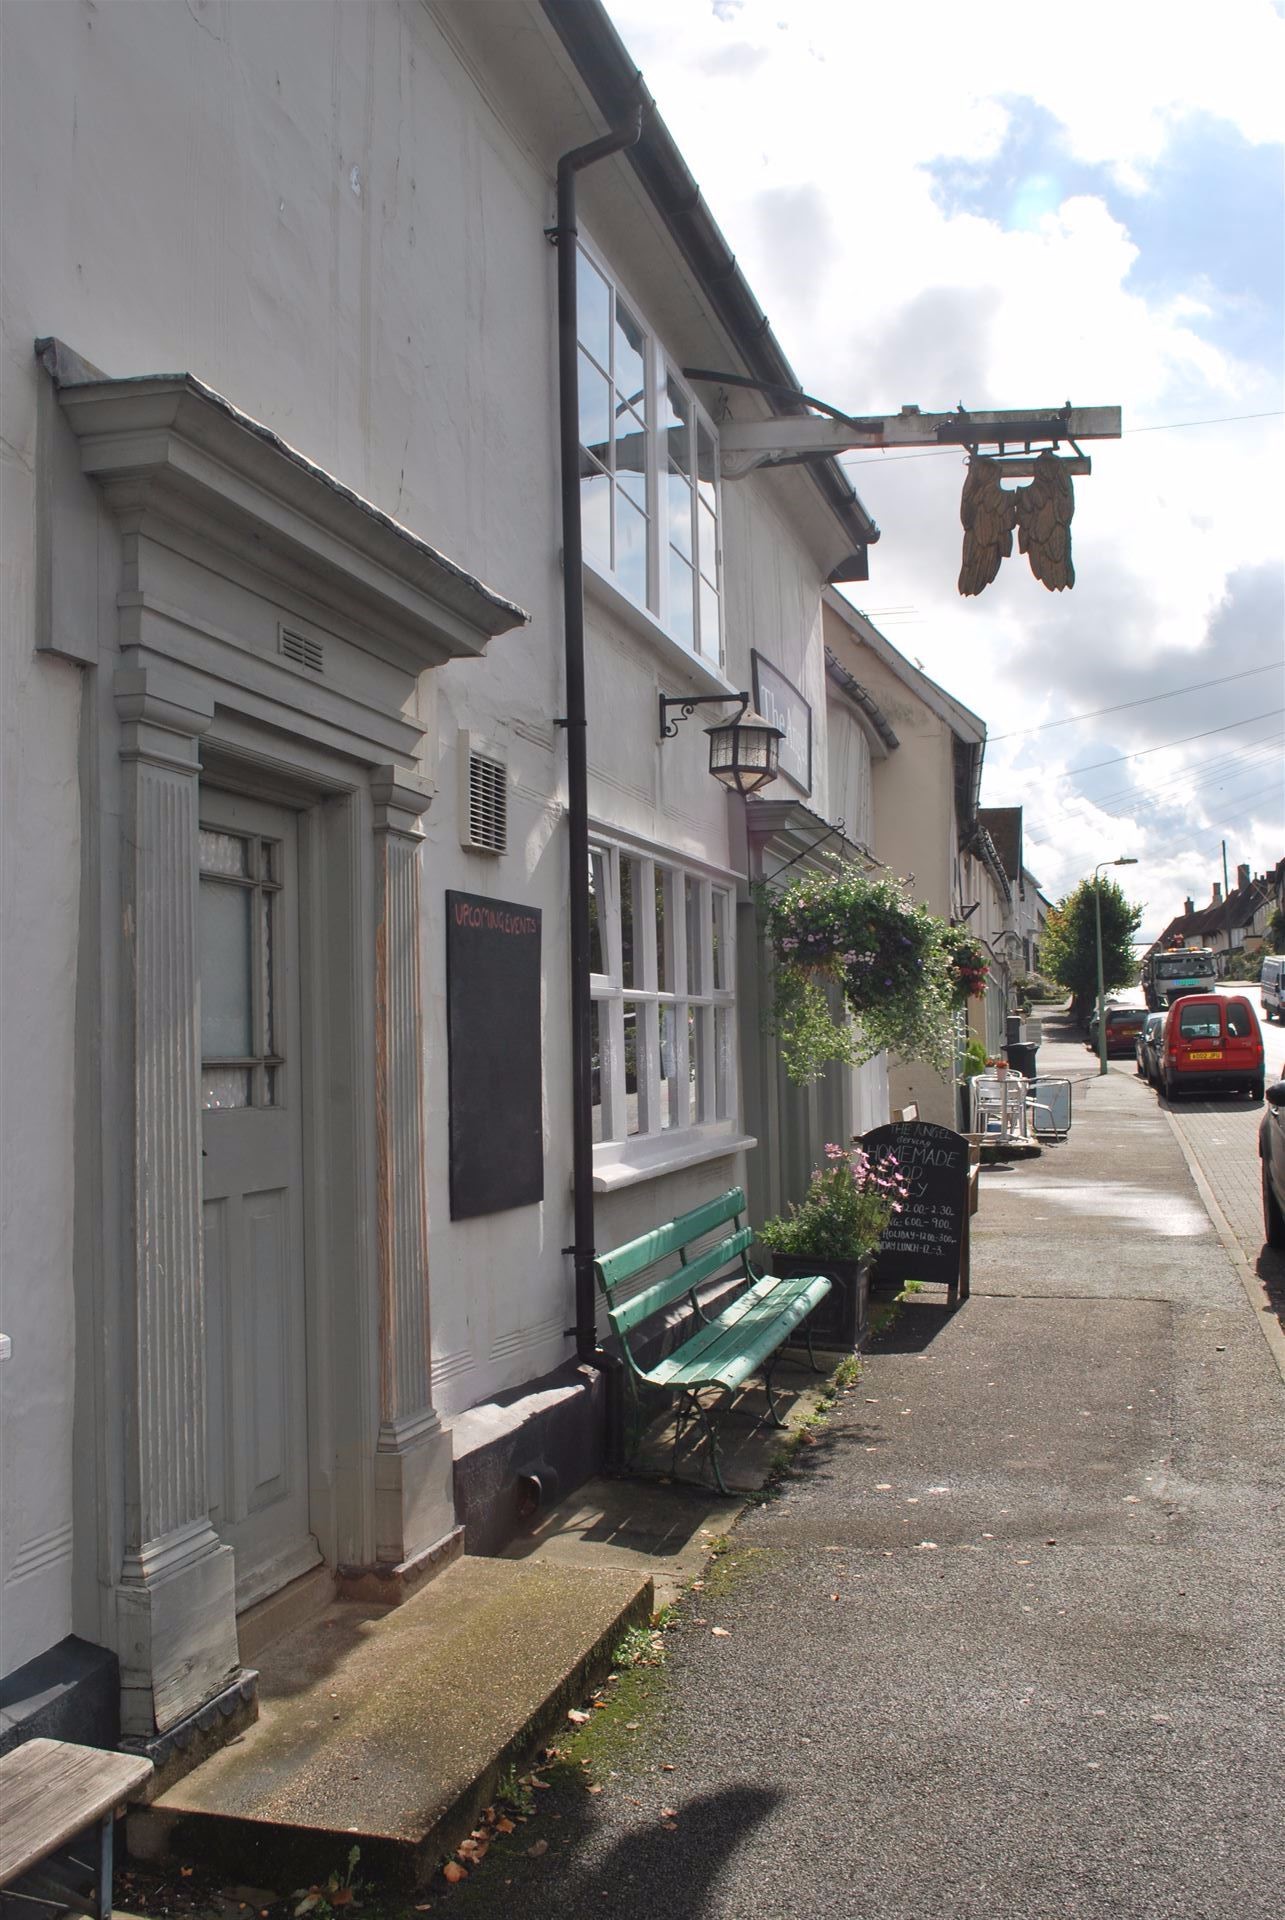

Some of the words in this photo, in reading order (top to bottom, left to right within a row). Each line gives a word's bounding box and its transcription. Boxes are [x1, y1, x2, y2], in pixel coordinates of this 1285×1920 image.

[761, 684, 785, 732] The
[786, 707, 808, 774] Angel
[914, 1124, 952, 1140] ANGEL
[867, 1143, 960, 1168] HOMEMADE
